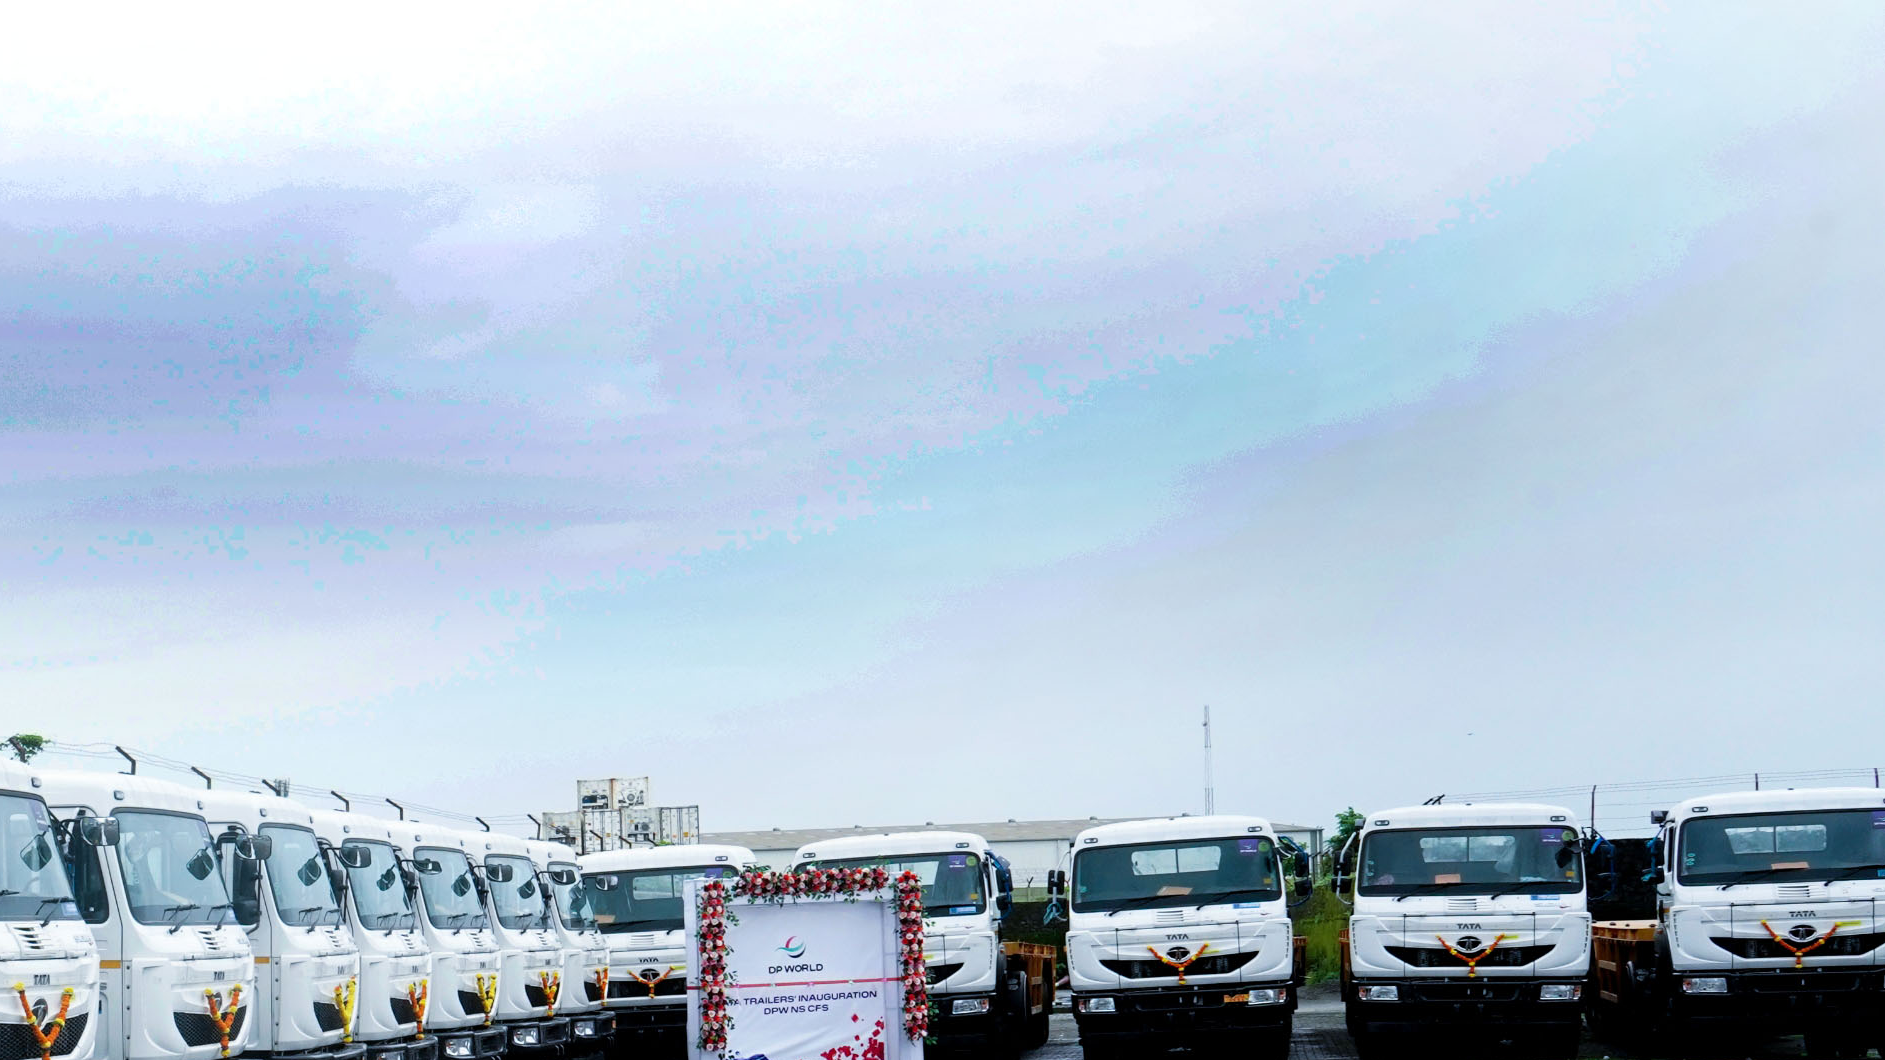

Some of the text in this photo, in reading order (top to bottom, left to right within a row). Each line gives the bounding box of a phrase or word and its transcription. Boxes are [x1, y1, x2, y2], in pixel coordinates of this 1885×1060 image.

[1789, 910, 1816, 918] TATA
[768, 963, 824, 975] DP WORLD
[33, 973, 51, 986] TATA
[743, 995, 797, 1006] TRAILERS'
[798, 990, 878, 1002] INAUGURATION
[763, 1004, 829, 1015] DPW NS CFS
